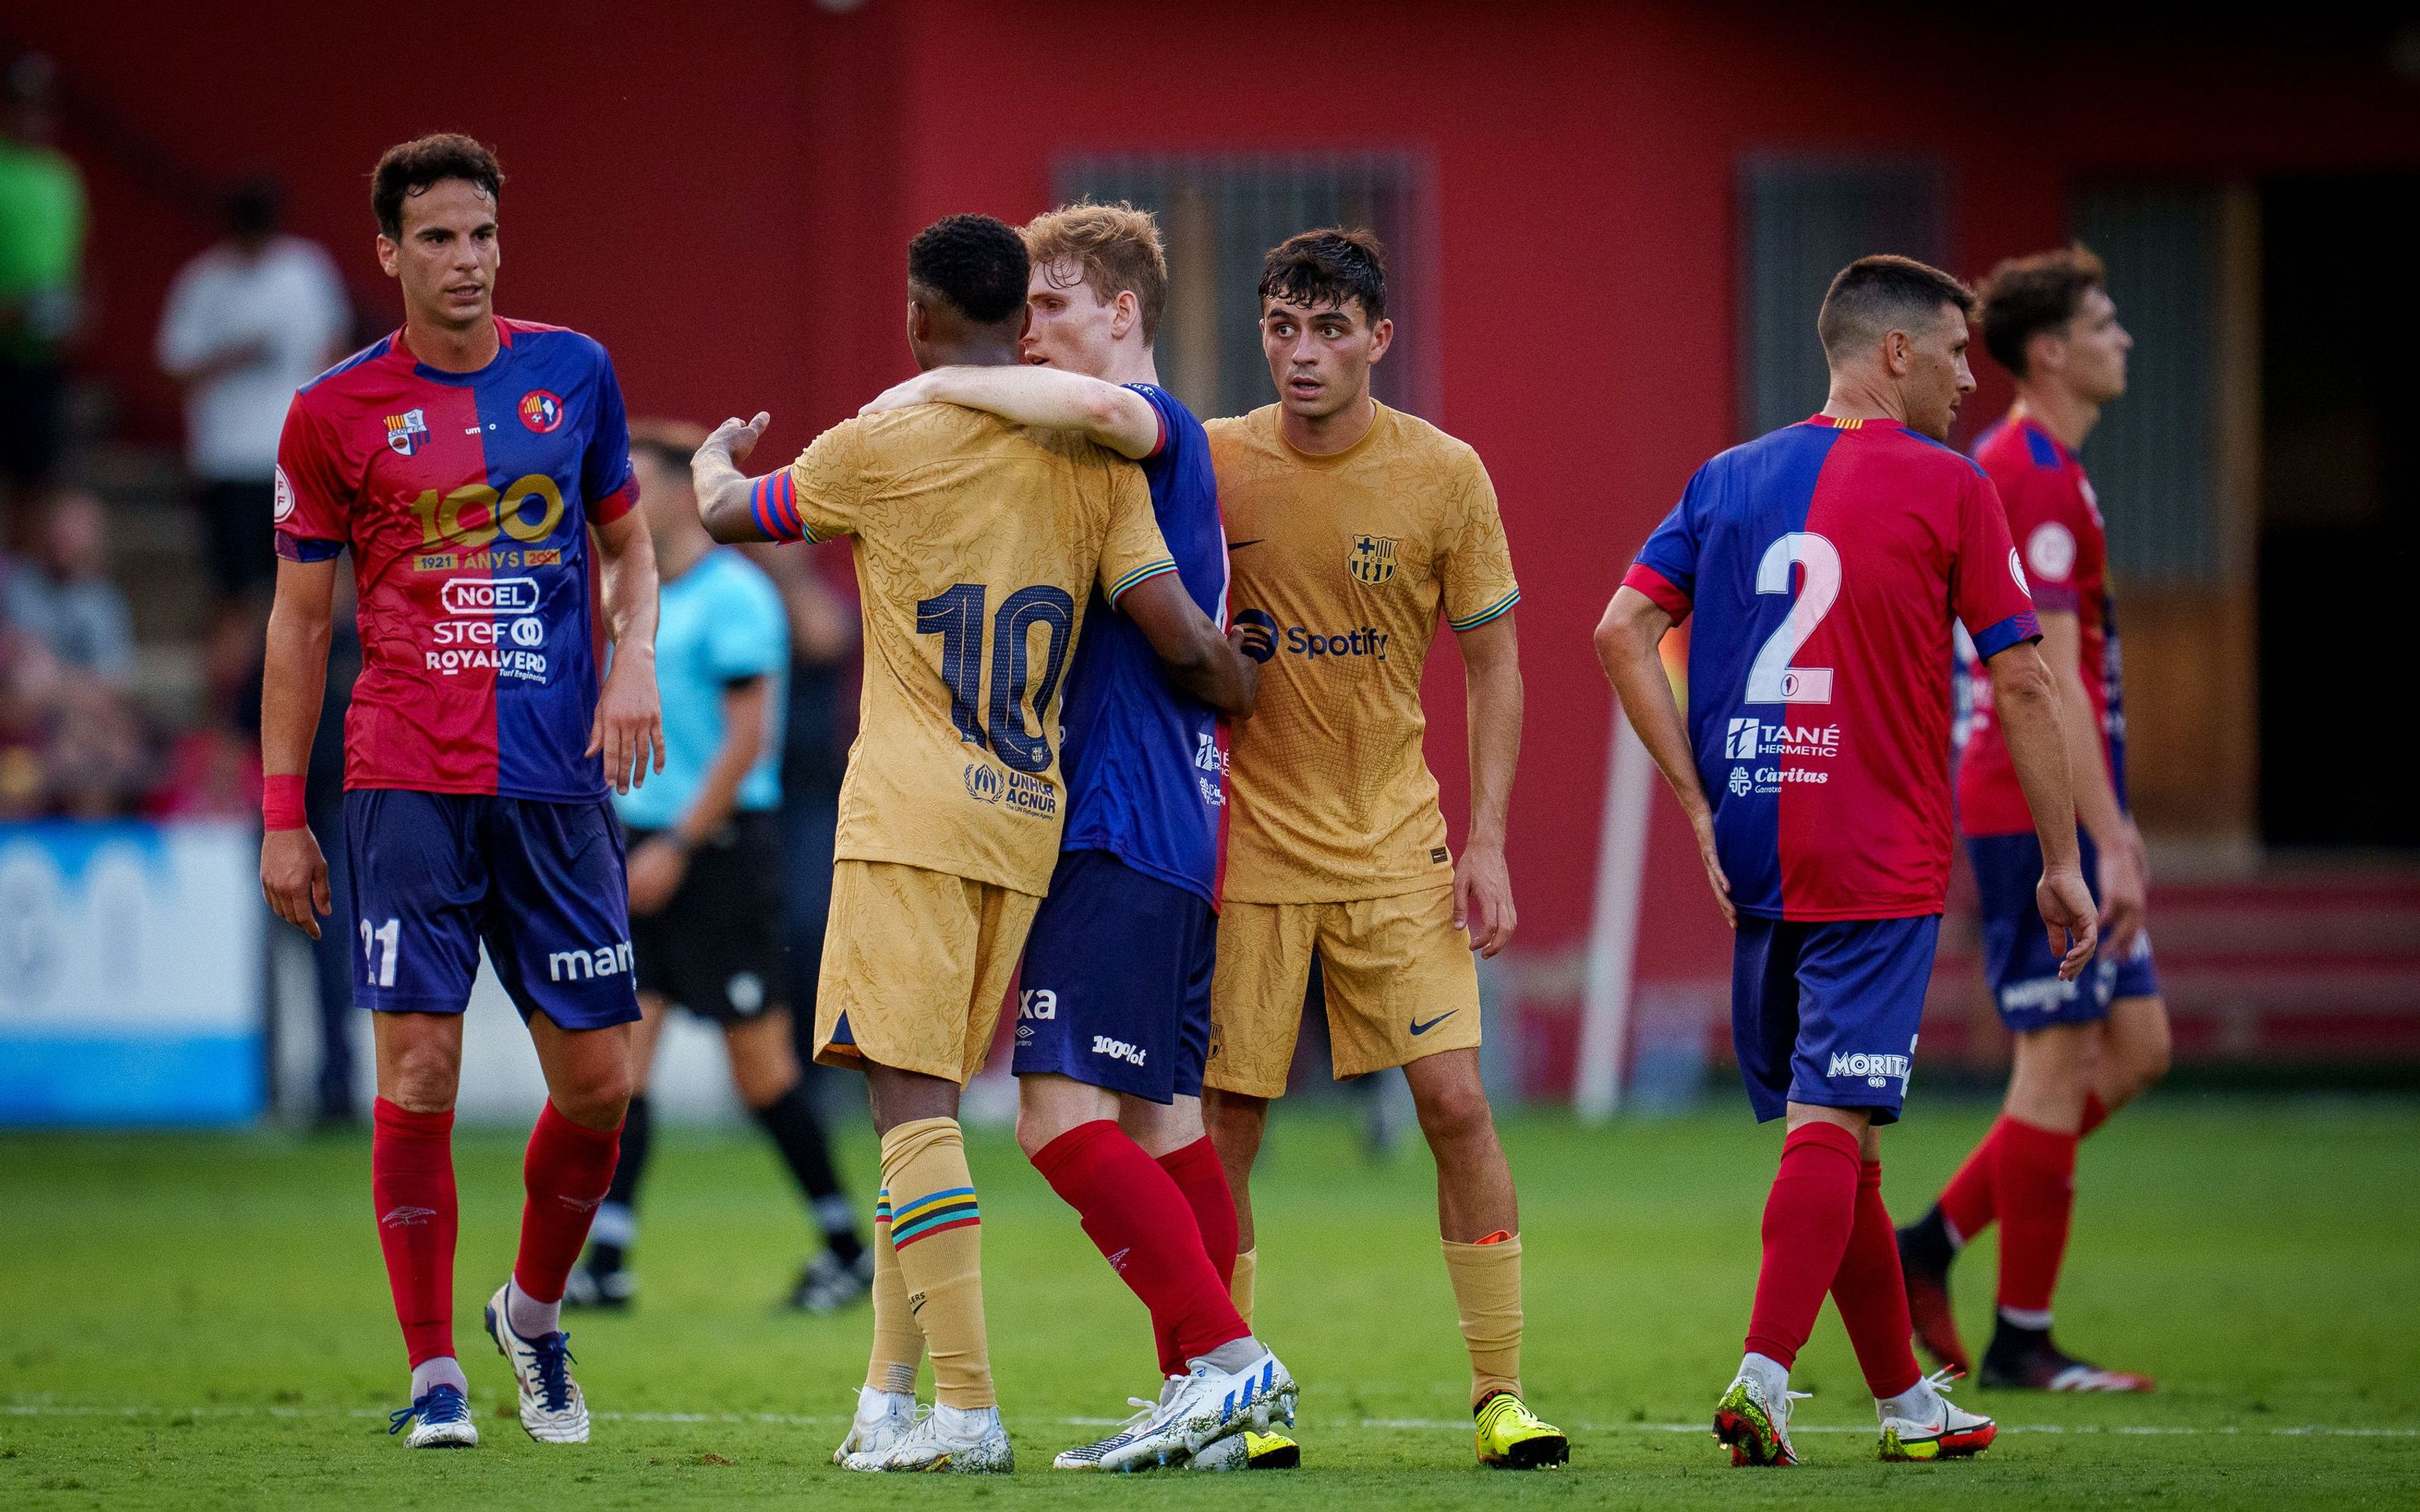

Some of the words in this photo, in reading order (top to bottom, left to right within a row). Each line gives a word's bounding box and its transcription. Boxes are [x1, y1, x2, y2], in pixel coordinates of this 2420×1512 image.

[410, 473, 565, 548] 100
[420, 556, 451, 569] 1921
[464, 551, 520, 569] ANYS
[458, 587, 526, 606] NOEL
[1745, 531, 1842, 705] 2
[1286, 626, 1388, 661] Spotify
[426, 649, 547, 675] ROYALVERD
[499, 668, 515, 677] Turf
[917, 584, 1074, 773] 10
[1761, 724, 1840, 746] TANÉ
[1758, 744, 1838, 758] HERMETIC
[1008, 771, 1055, 798] UNHCR
[1754, 767, 1829, 784] Càritas
[1754, 785, 1782, 794] Garrotxa
[1006, 789, 1056, 814] ACNUR
[1022, 807, 1040, 817] Refugee
[1039, 812, 1053, 822] Agency
